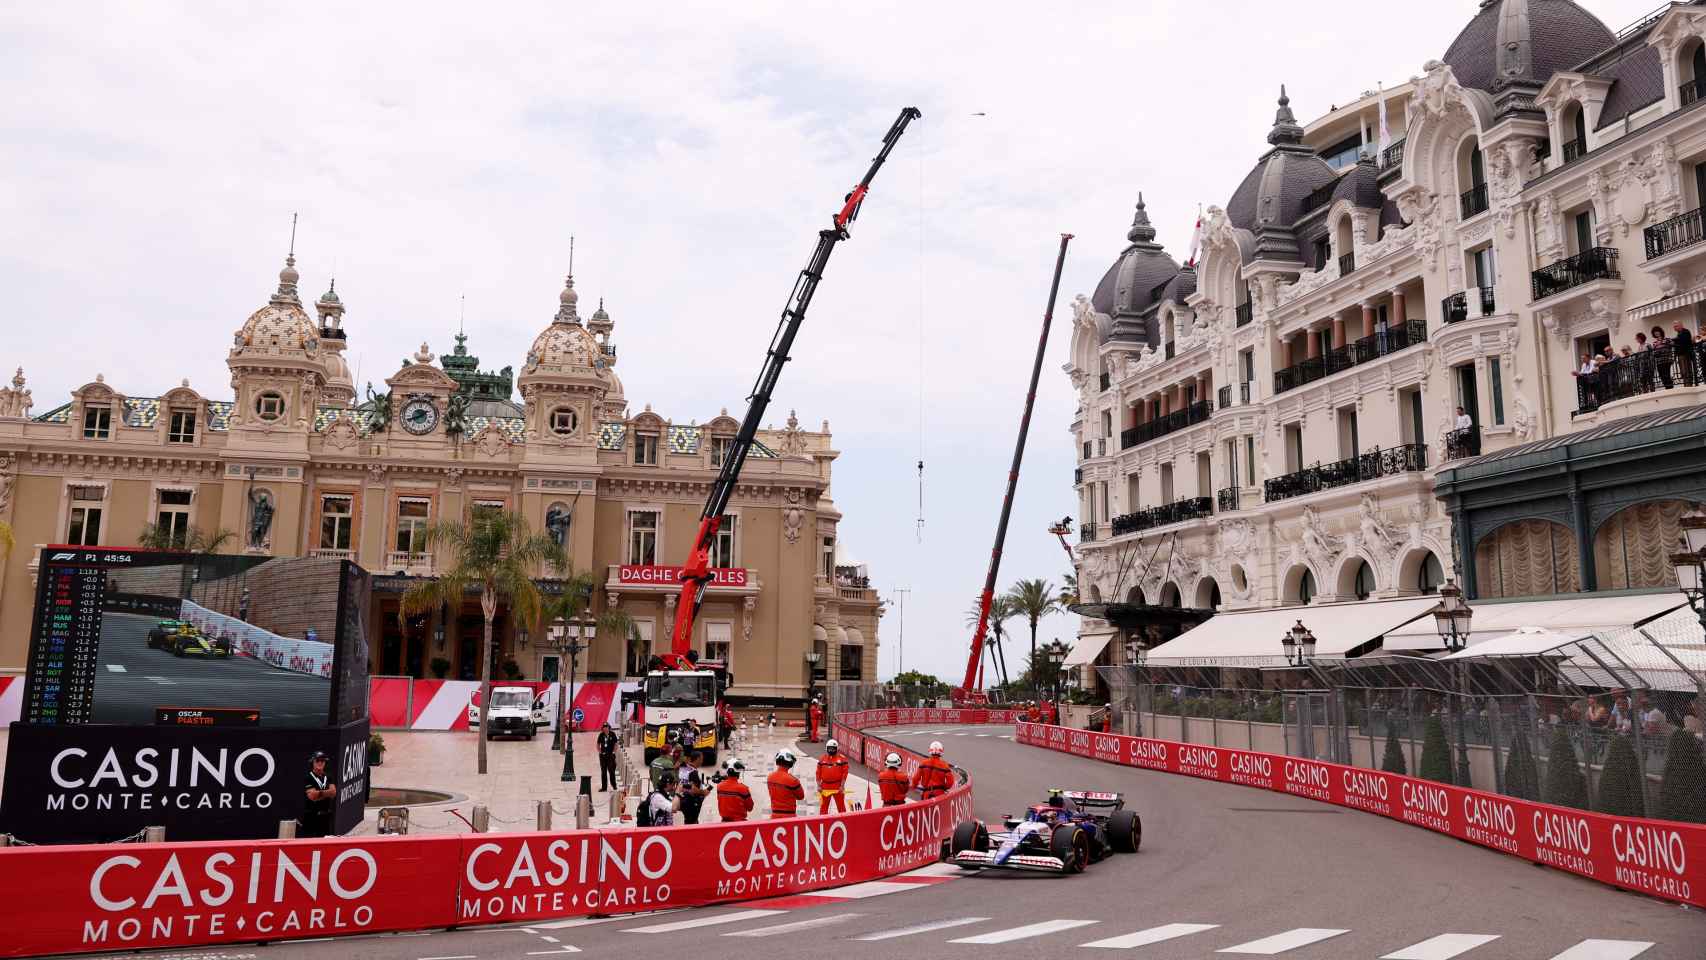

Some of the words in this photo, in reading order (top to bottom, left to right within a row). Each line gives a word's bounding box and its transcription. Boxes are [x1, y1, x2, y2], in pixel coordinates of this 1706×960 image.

[104, 554, 132, 562] 45:54
[622, 568, 672, 580] DAGHE
[1095, 736, 1120, 752] CASINO
[1130, 740, 1167, 761] CASINO
[1178, 746, 1218, 768] CASINO
[50, 746, 276, 790] CASINO
[1230, 752, 1272, 777] CASINO
[1285, 760, 1329, 788] CASINO
[1286, 783, 1307, 795] MONTE
[1308, 787, 1330, 800] CARLO
[1343, 770, 1388, 800] CASINO
[1402, 782, 1448, 816] CASINO
[46, 794, 153, 810] MONTE
[176, 792, 273, 809] CARLO
[1464, 795, 1516, 836] CASINO
[880, 804, 940, 852] CASINO
[1403, 809, 1426, 824] MONTE
[1427, 815, 1450, 832] CARLO
[1534, 810, 1590, 854] CASINO
[719, 820, 848, 873] CASINO
[1466, 825, 1490, 844] MONTE
[1492, 832, 1518, 854] CARLO
[1612, 824, 1686, 875] CASINO
[466, 834, 673, 892] CASINO
[878, 850, 912, 870] MONTE
[918, 840, 940, 860] CARLO
[1536, 847, 1564, 868] MONTE
[1566, 853, 1594, 875] CARLO
[90, 848, 377, 912] CASINO
[717, 876, 784, 896] MONTE
[798, 863, 848, 884] CARLO
[1616, 866, 1650, 890] MONTE
[1654, 876, 1690, 899] CARLO
[462, 892, 565, 918] MONTE
[584, 884, 671, 908] CARLO
[82, 912, 225, 944] MONTE
[255, 904, 374, 933] CARLO
